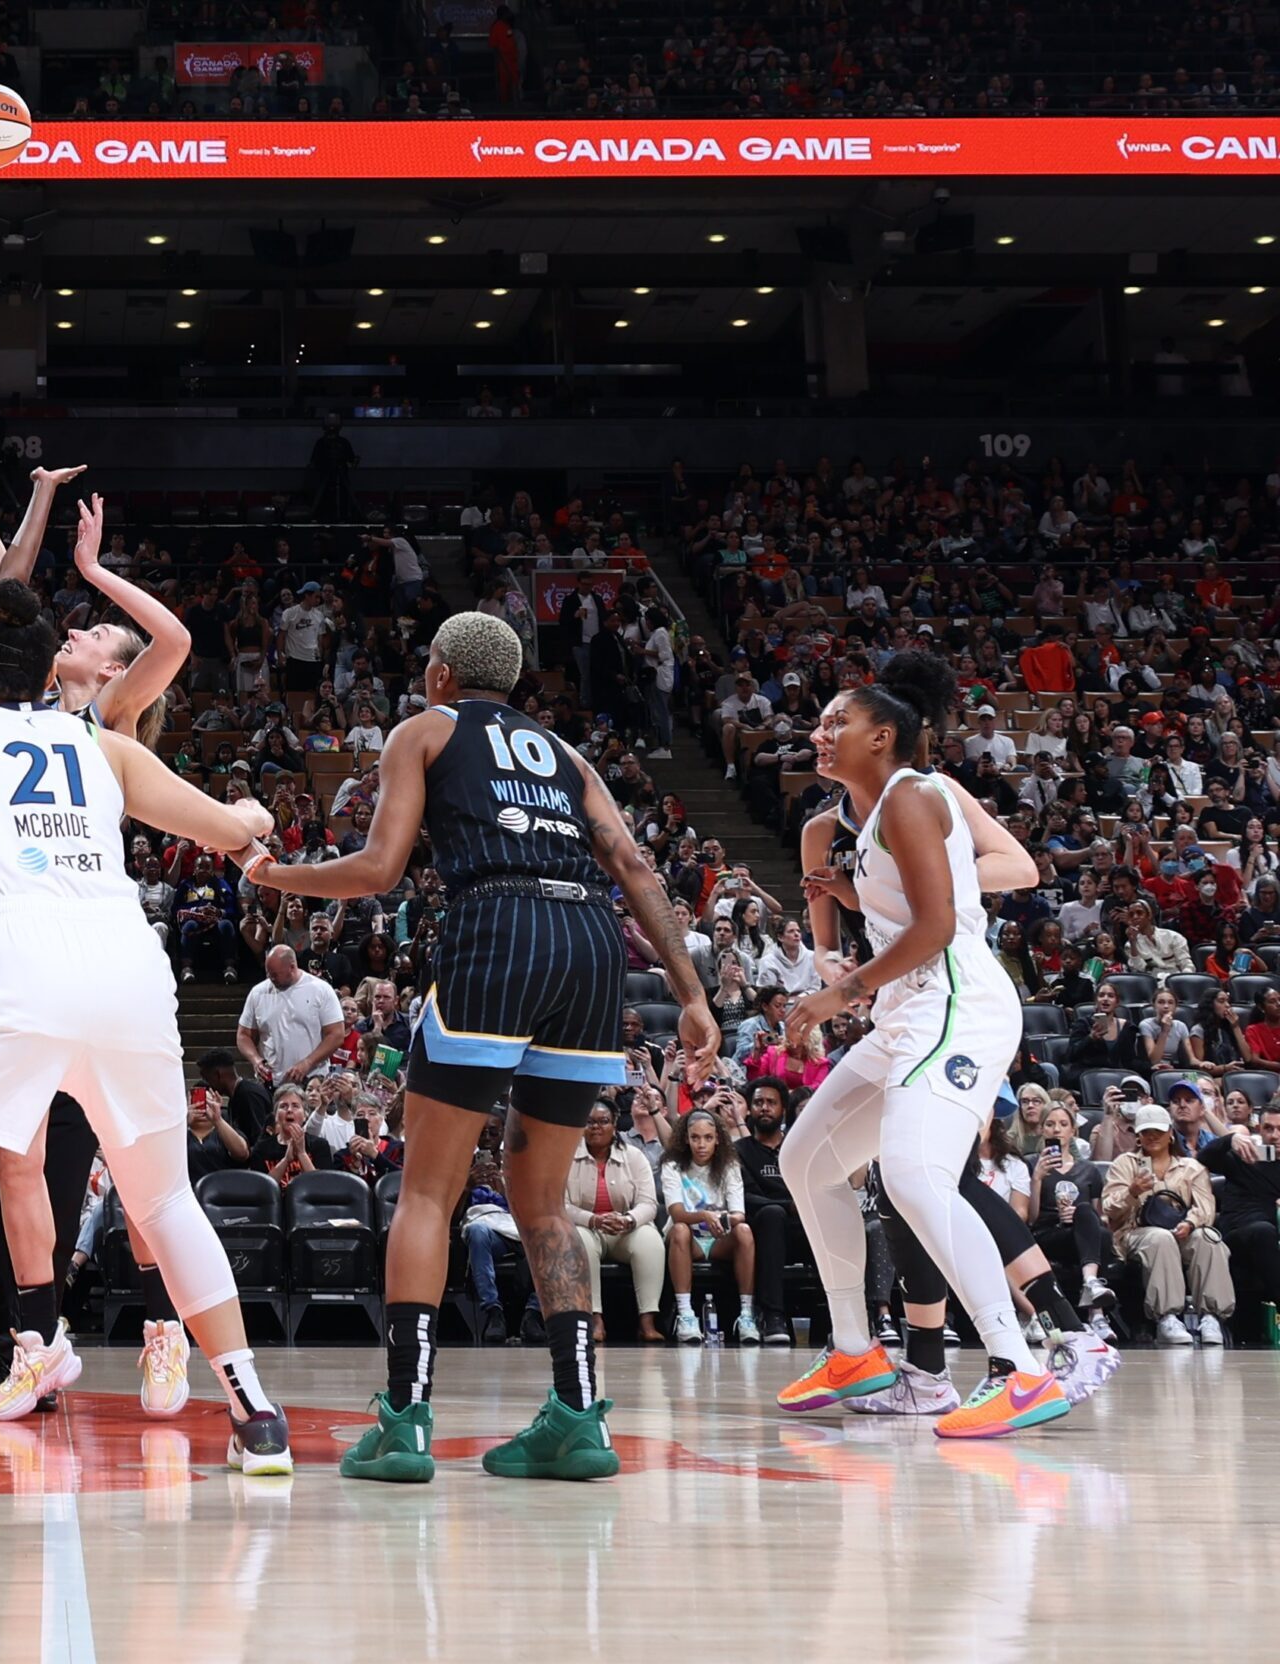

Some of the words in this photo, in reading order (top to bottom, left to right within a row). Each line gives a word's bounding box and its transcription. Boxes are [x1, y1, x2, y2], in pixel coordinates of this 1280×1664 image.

[95, 140, 227, 164] GAME
[238, 147, 263, 155] Presented
[271, 146, 312, 156] Tangerine
[480, 146, 524, 155] WNBA
[534, 138, 726, 162] CANADA
[738, 137, 872, 161] GAME
[883, 145, 908, 153] Presented
[917, 143, 957, 154] Tangerine
[1126, 143, 1171, 153] WNBA
[1181, 136, 1280, 160] CAN
[979, 433, 1031, 458] 109
[484, 723, 558, 778] 10
[2, 740, 87, 808] 21
[490, 780, 572, 816] WILLIAMS
[13, 813, 91, 839] MCBRIDE
[532, 817, 580, 839] AT&T
[54, 853, 103, 872] AT&T
[320, 1257, 343, 1277] 35
